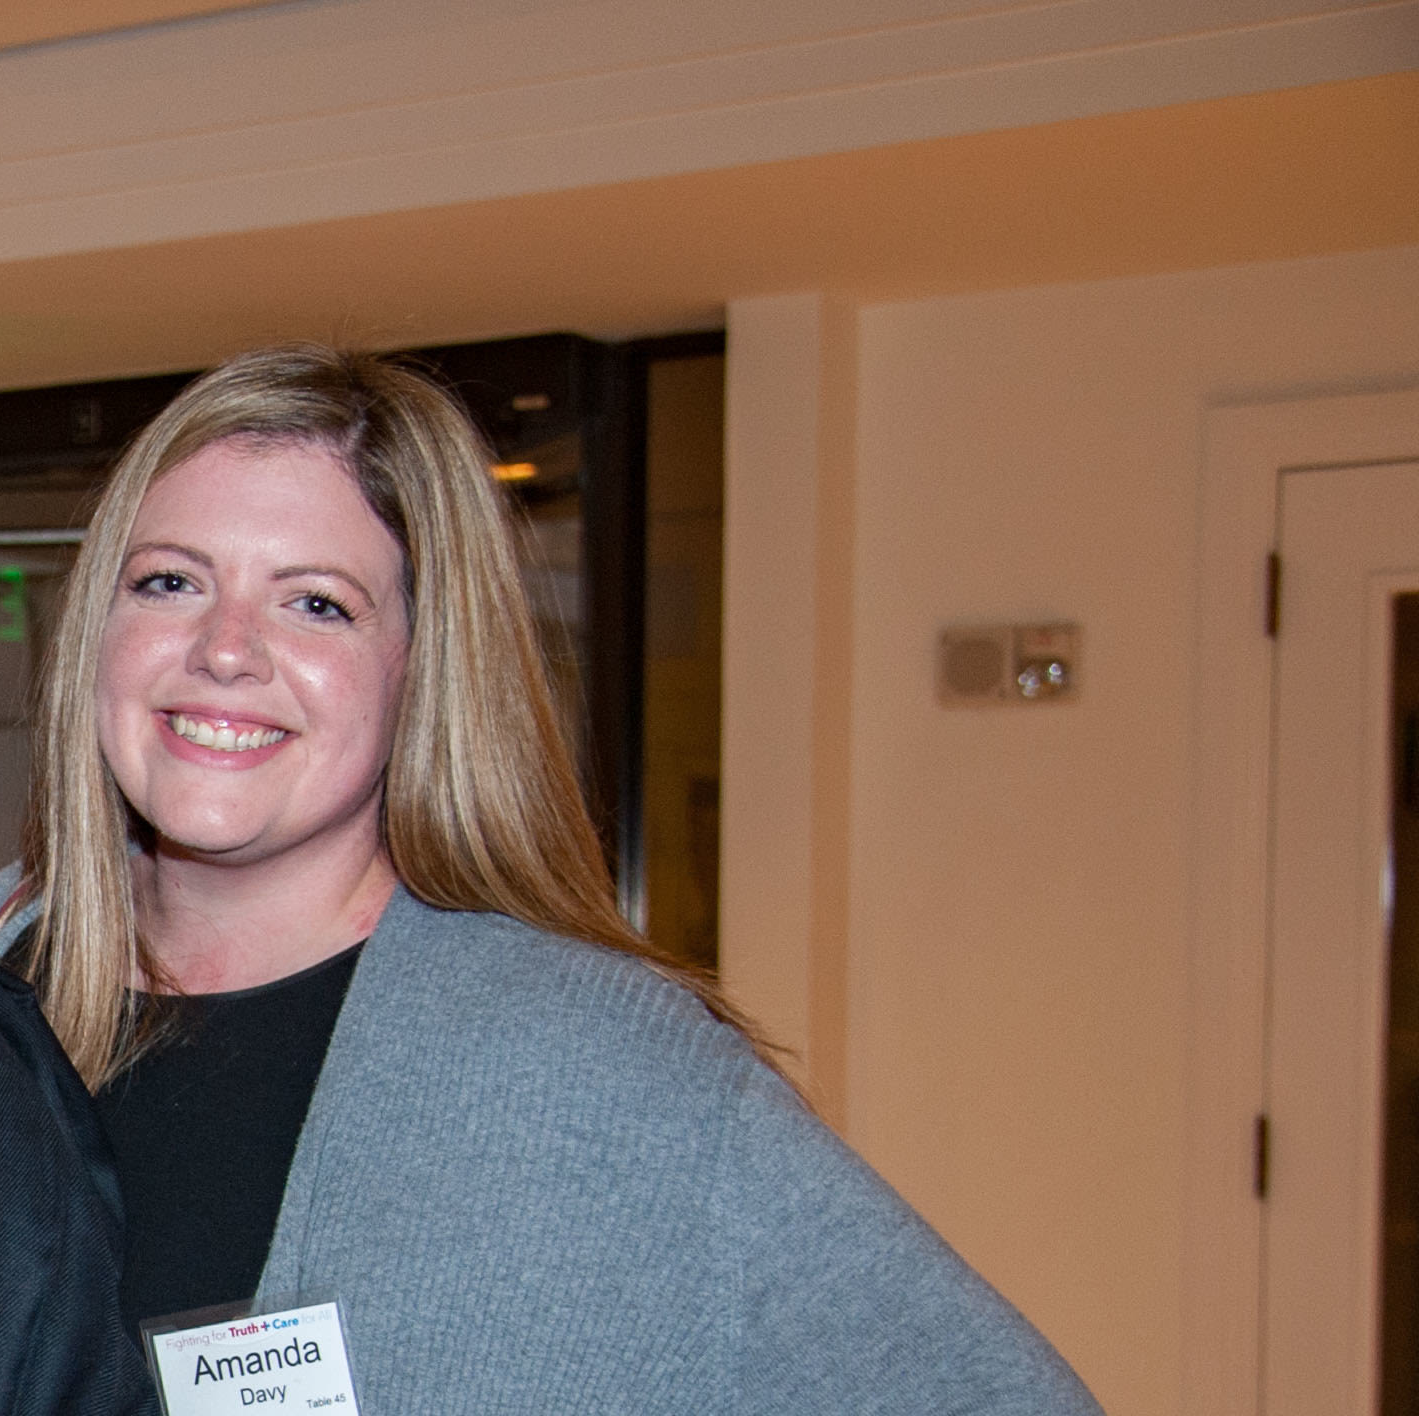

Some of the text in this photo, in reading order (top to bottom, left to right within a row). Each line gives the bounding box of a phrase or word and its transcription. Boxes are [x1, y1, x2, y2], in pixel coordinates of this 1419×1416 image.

[228, 1323, 259, 1338] Truth
[272, 1317, 299, 1330] Care
[194, 1337, 322, 1386] Amanda
[240, 1385, 287, 1406] Davy
[306, 1396, 332, 1410] Table
